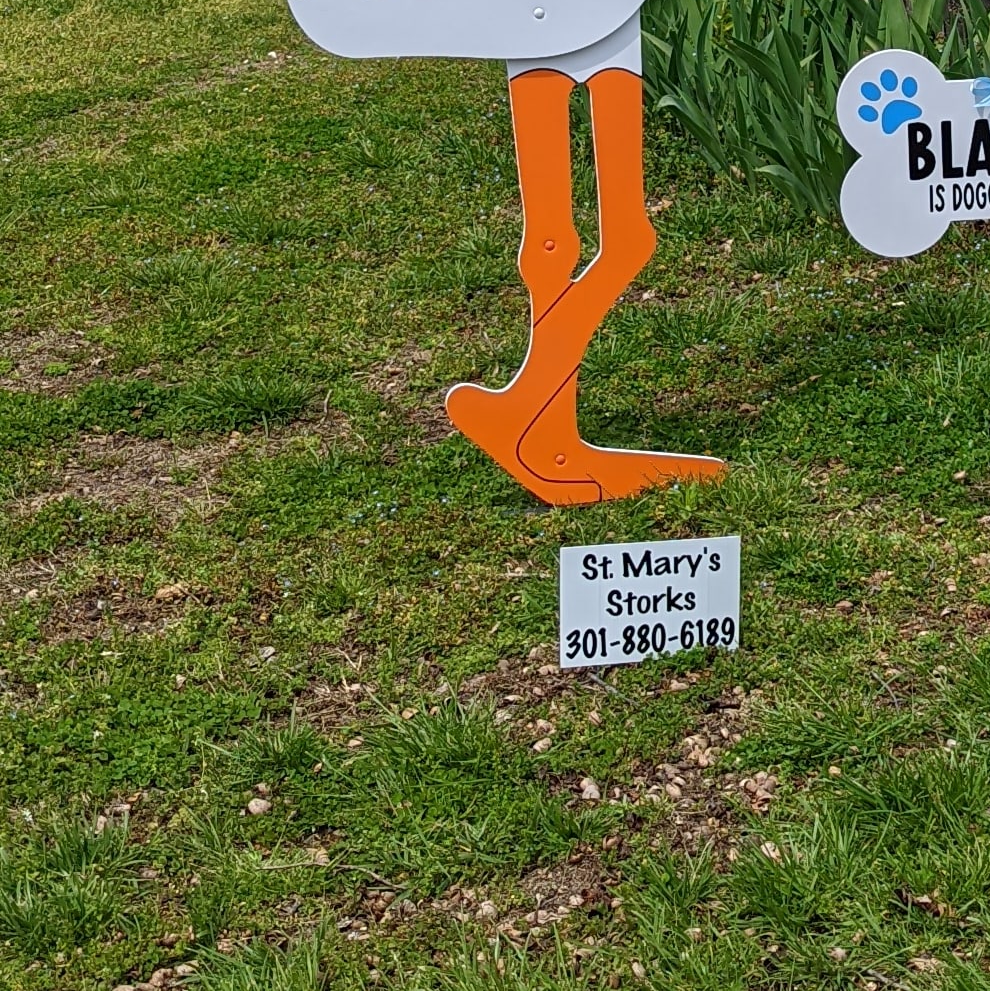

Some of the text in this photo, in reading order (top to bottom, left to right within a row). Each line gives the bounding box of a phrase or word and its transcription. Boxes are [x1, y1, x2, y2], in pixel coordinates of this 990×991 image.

[929, 184, 946, 213] IS
[581, 546, 721, 581] St. Mary's
[606, 585, 697, 617] Storks
[565, 616, 736, 660] 301-880-6189
